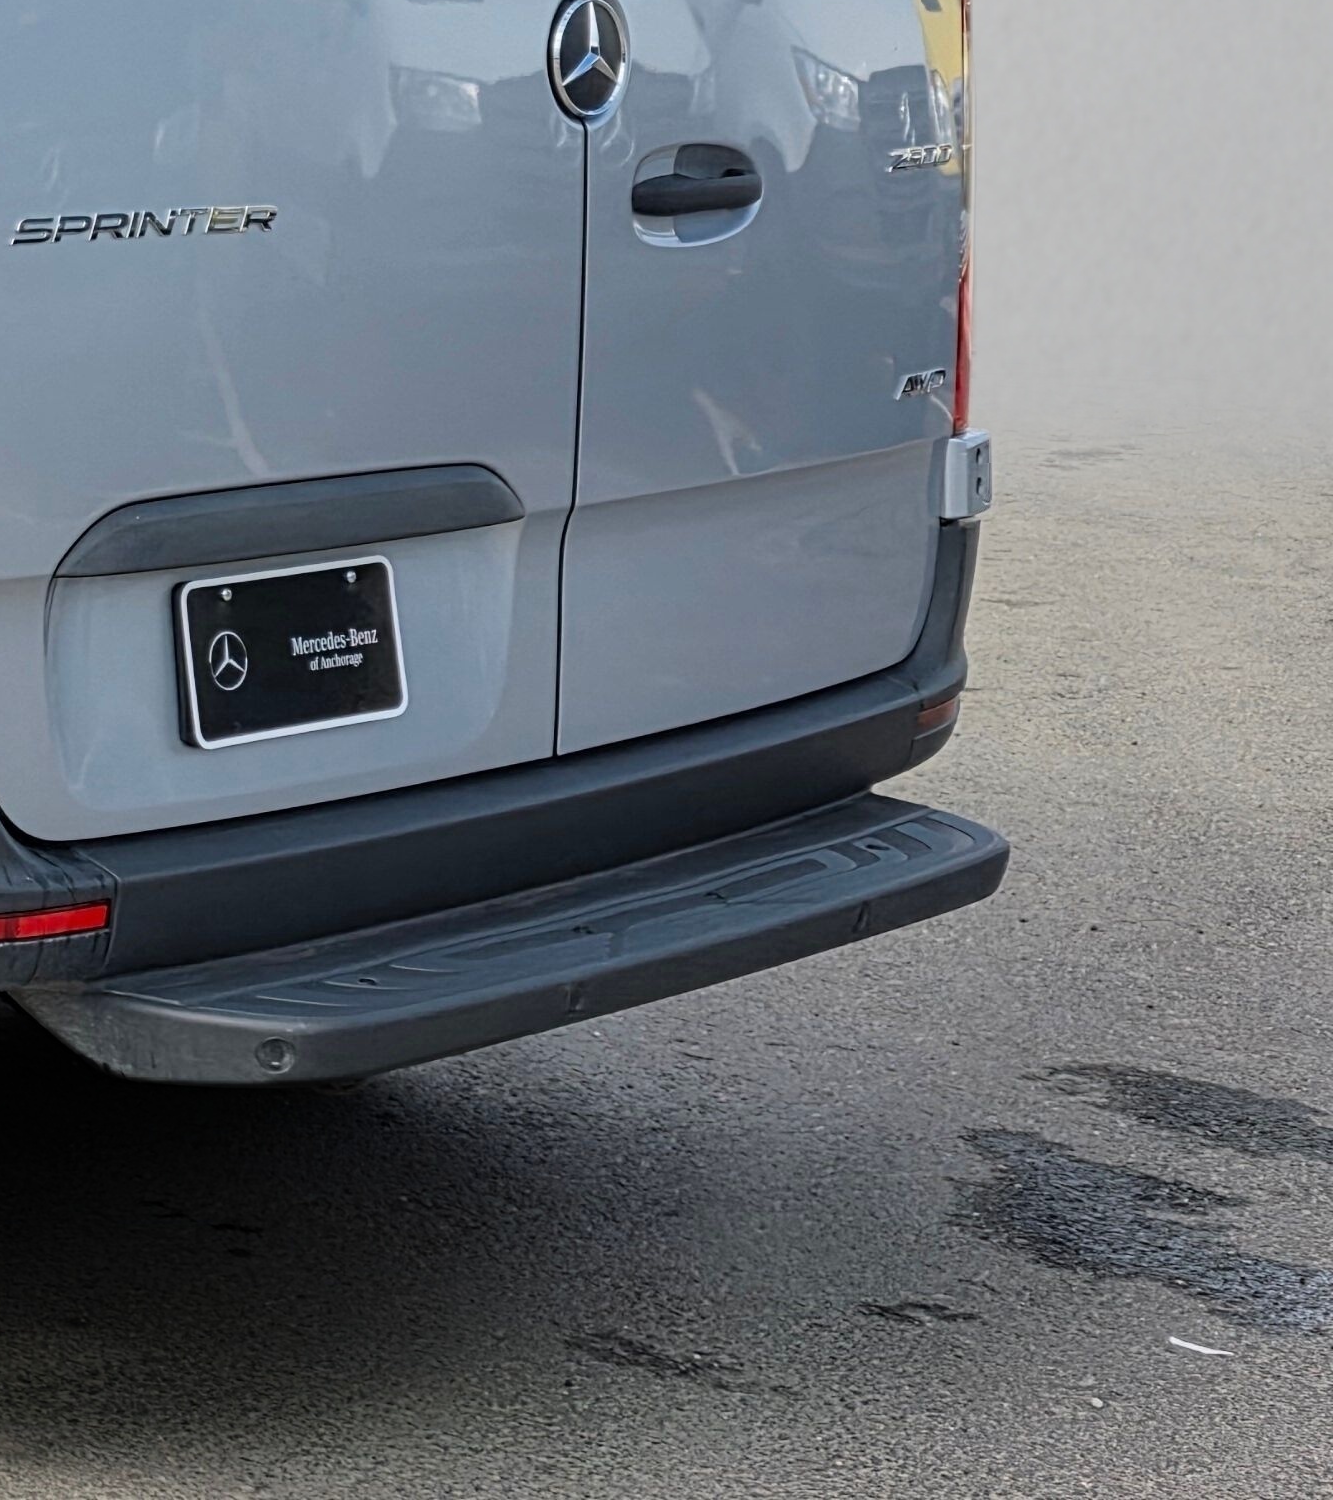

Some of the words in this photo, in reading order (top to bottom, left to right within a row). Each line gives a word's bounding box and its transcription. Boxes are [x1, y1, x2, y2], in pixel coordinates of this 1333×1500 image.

[9, 205, 278, 246] SPRINTER
[290, 628, 379, 656] Mercedes-Benz
[310, 656, 319, 671] of
[320, 653, 364, 670] Anchorage
